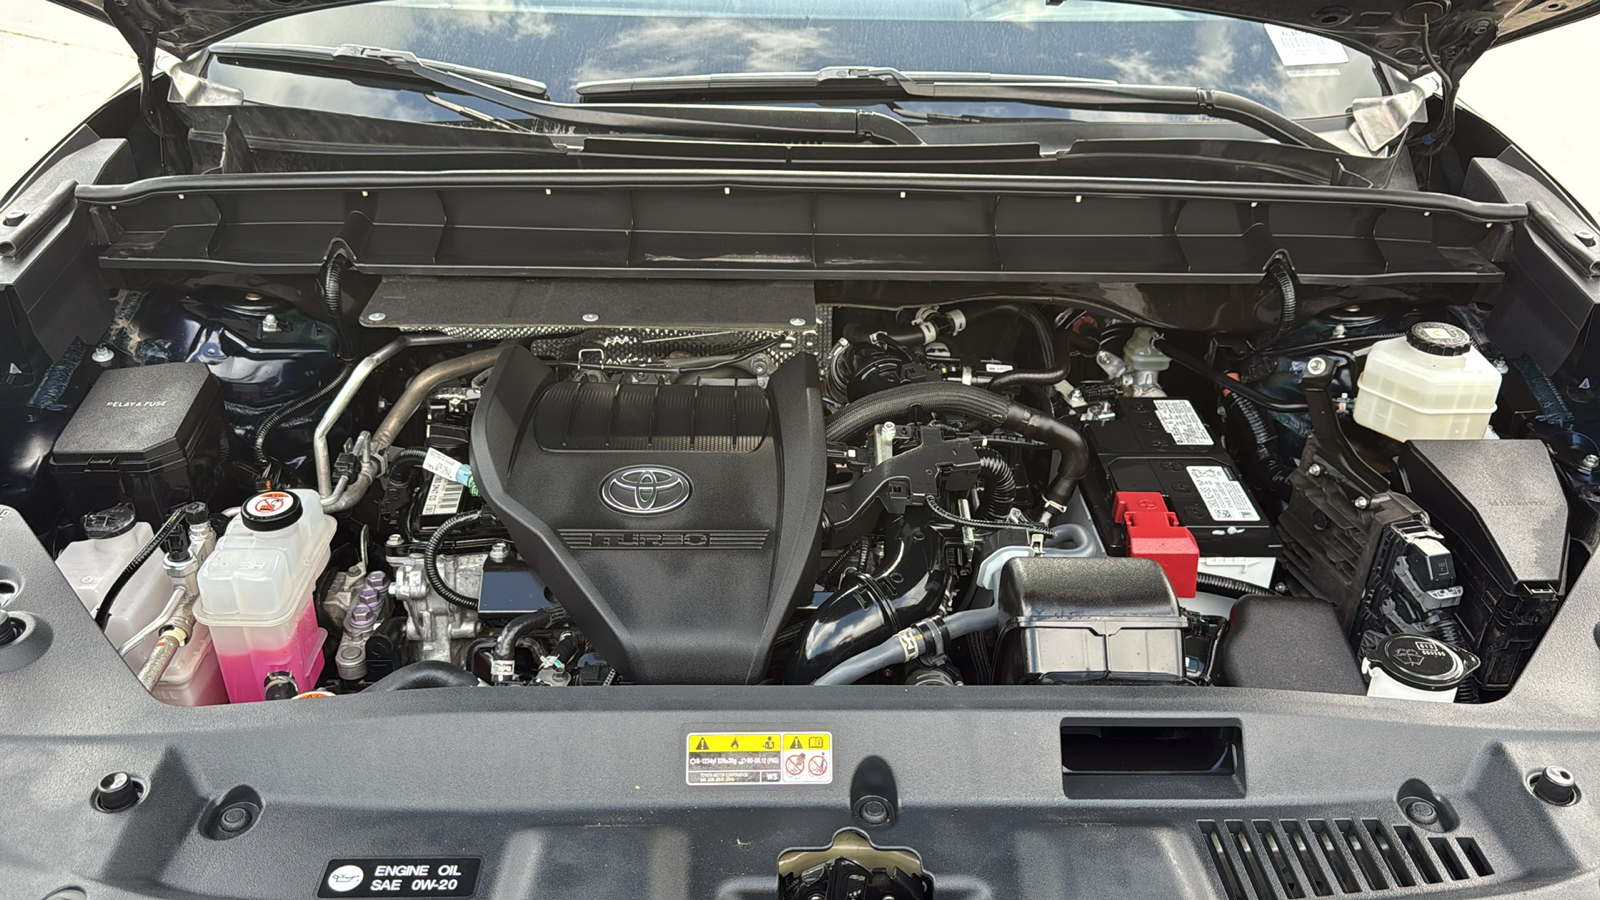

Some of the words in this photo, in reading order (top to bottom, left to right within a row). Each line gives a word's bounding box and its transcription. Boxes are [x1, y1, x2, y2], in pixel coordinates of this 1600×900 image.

[594, 533, 708, 546] TURBO
[766, 773, 778, 781] WS
[374, 865, 430, 877] ENGINE
[437, 865, 462, 876] OIL
[370, 879, 403, 891] SAE
[411, 879, 458, 891] 0W-20
